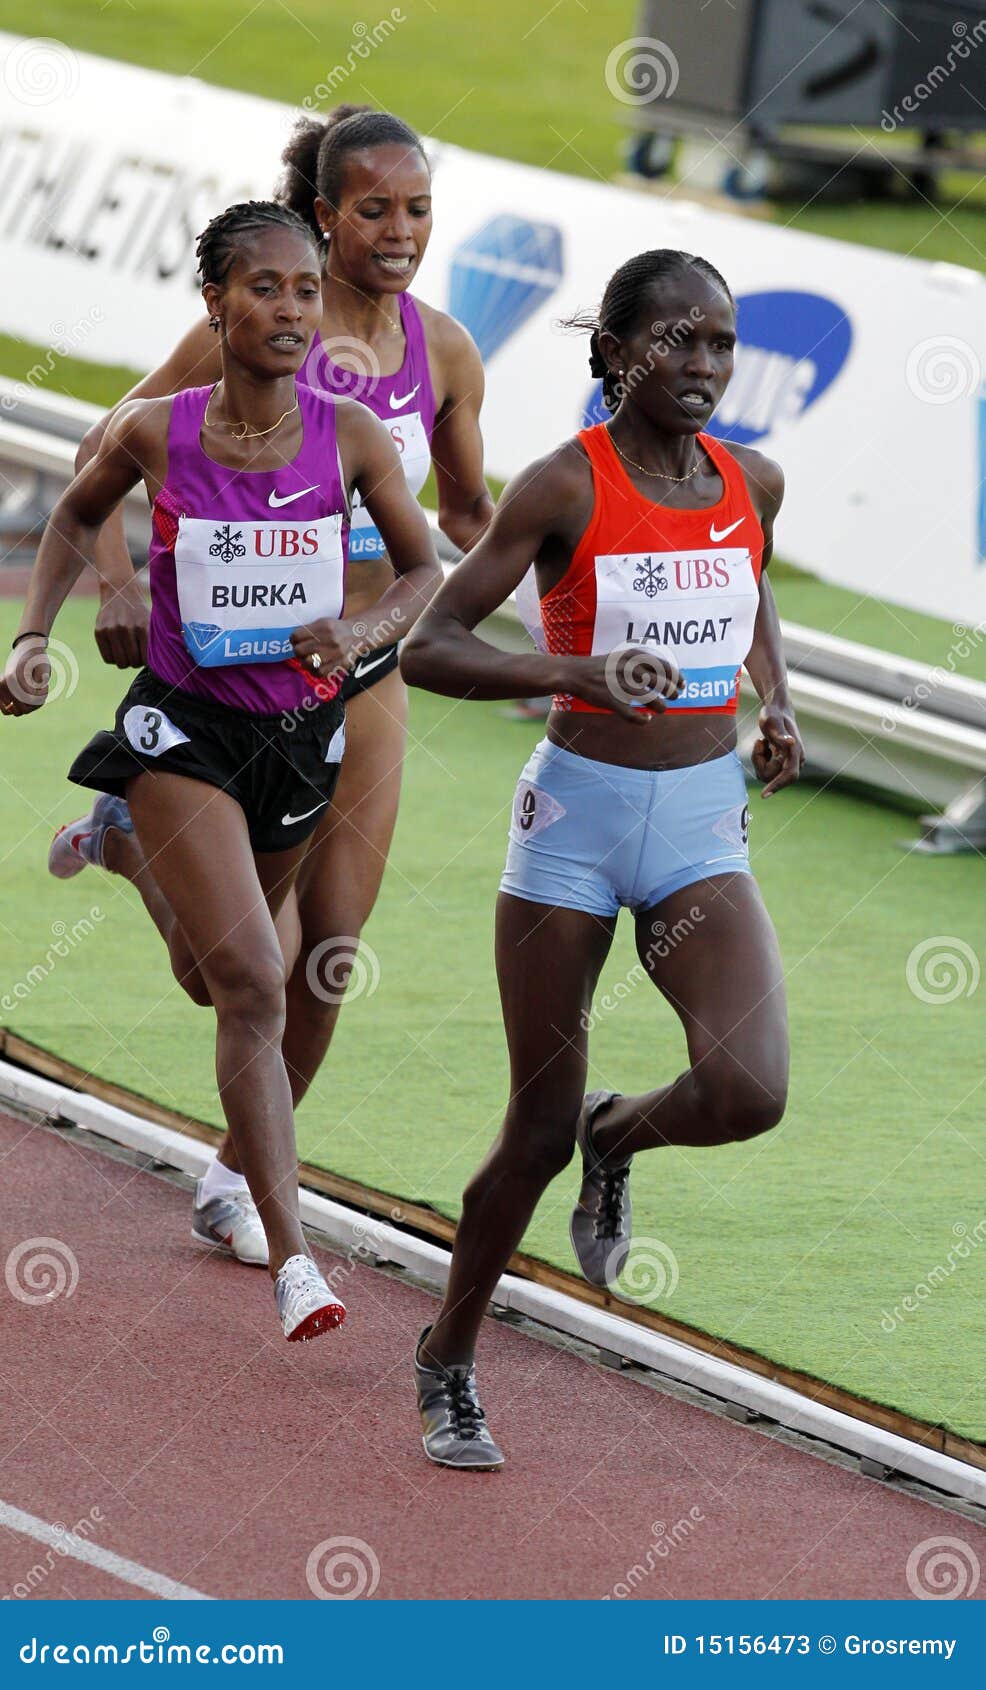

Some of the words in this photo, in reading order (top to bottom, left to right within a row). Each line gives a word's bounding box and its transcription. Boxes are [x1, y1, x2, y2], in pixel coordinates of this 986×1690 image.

[253, 528, 319, 557] UBS
[673, 558, 730, 590] UBS
[212, 583, 307, 608] BURKA
[626, 617, 732, 645] LANGAT
[224, 639, 294, 657] Lausa
[140, 711, 162, 750] 3
[520, 789, 535, 831] 9
